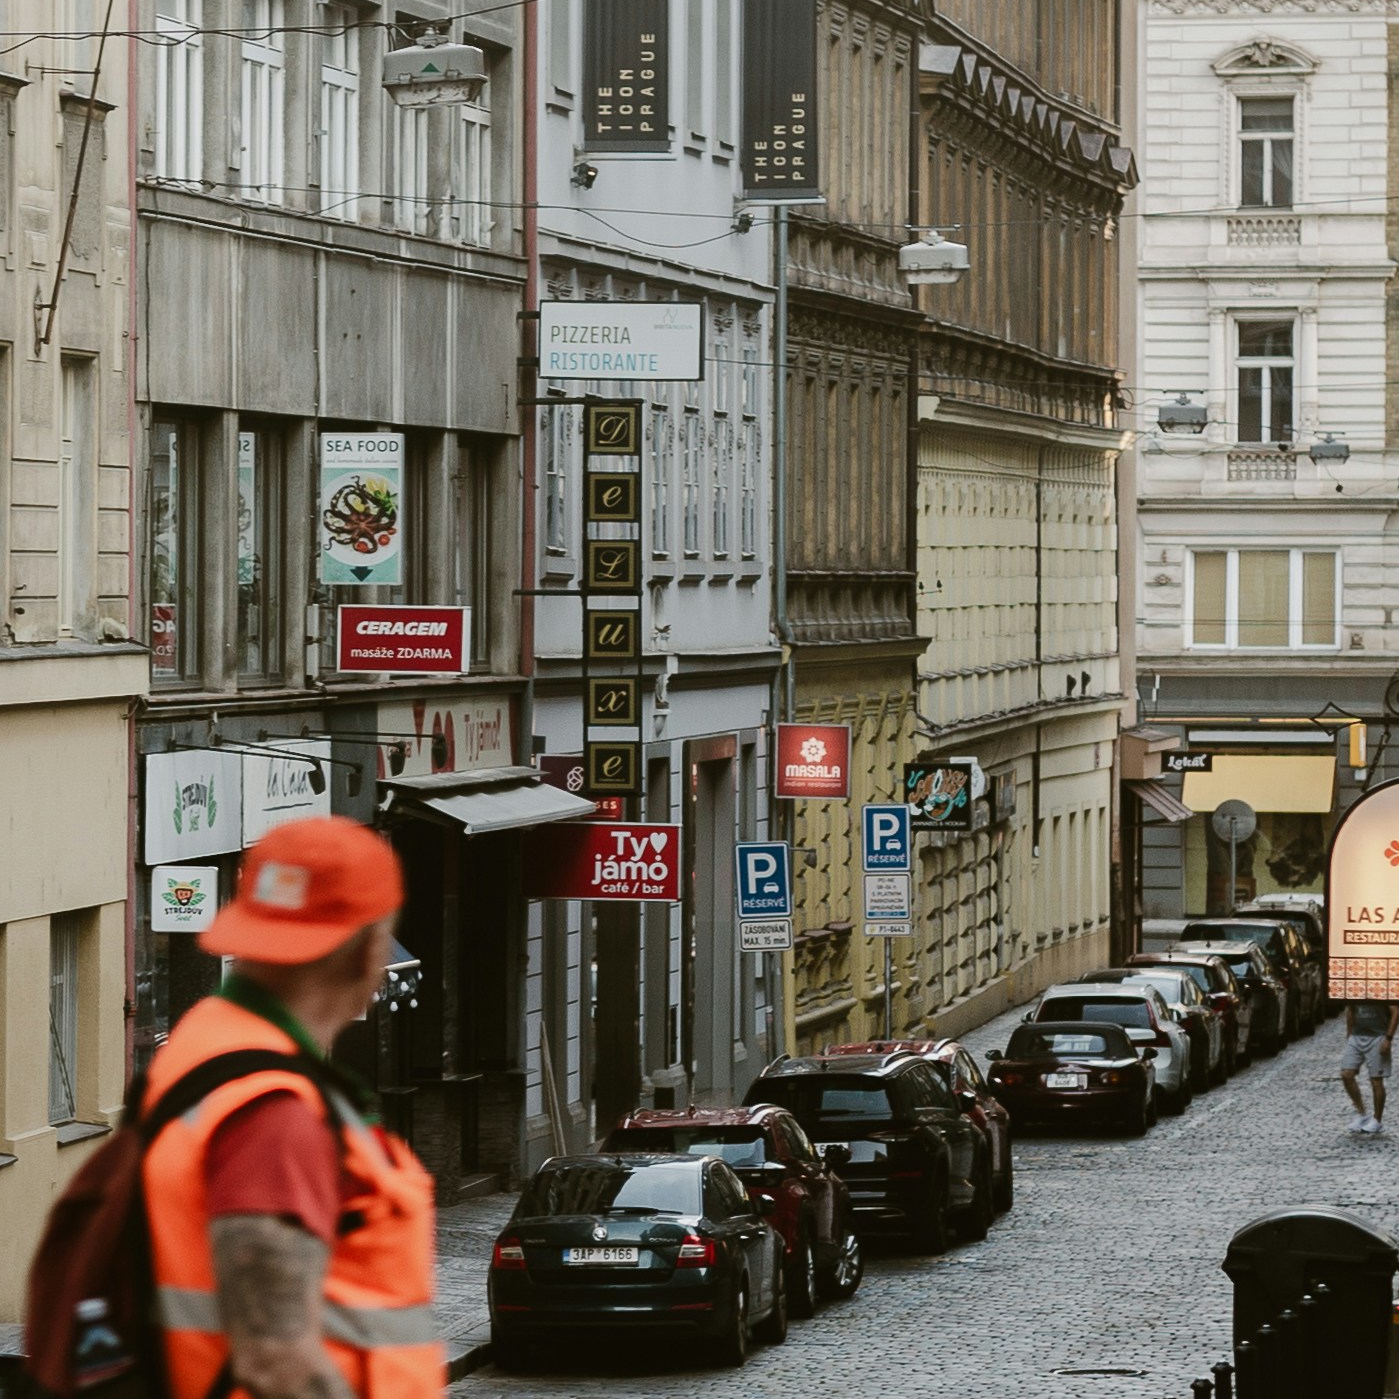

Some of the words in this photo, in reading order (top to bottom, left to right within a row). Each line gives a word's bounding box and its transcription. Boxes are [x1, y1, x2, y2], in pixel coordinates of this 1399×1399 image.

[640, 33, 655, 132] PRAGUE
[619, 69, 634, 130] ICON
[597, 87, 613, 133] THE
[792, 93, 806, 180] PRAGUE
[754, 141, 768, 182] THE
[773, 125, 787, 179] ICON
[550, 325, 632, 344] PIZZERIA
[550, 352, 658, 372] RISTORANTE
[326, 440, 352, 452] SEA
[358, 440, 399, 452] FOOD
[356, 620, 448, 636] CERAGEM
[350, 646, 394, 658] masáže
[397, 647, 452, 659] ZDARMA
[785, 764, 841, 778] MASALA
[873, 813, 900, 851] P
[610, 831, 649, 861] Ty
[868, 853, 906, 863] RÉSERVÉ
[747, 853, 777, 894] P
[601, 882, 630, 893] café
[642, 883, 665, 894] bar
[743, 897, 785, 908] RÉSERVÉ
[1347, 906, 1385, 924] LAS
[1345, 932, 1399, 944] RESTAUR
[573, 1249, 594, 1261] 3AP
[603, 1248, 633, 1260] 6166
